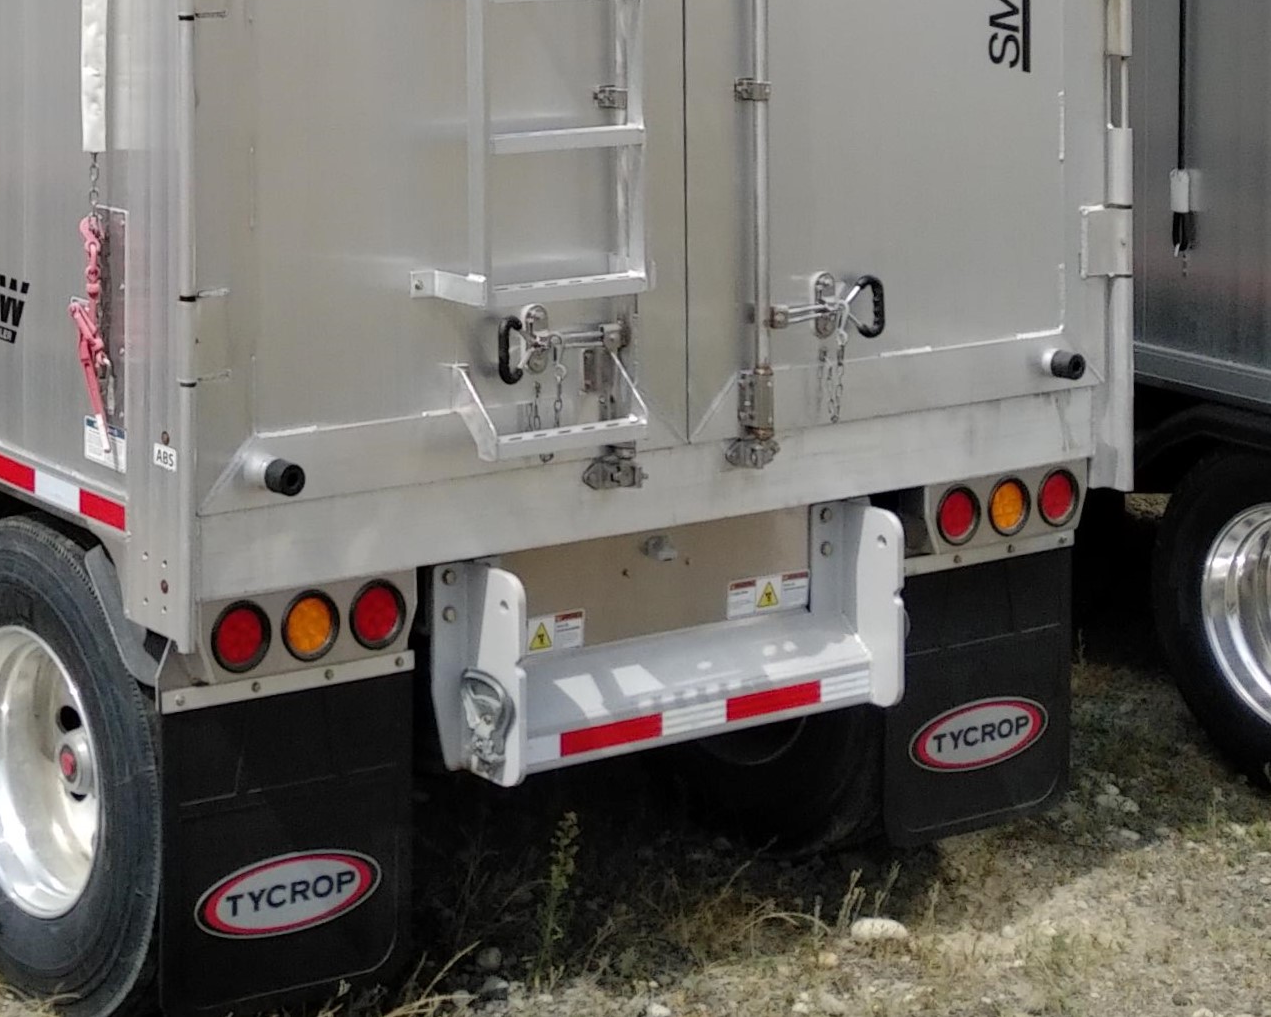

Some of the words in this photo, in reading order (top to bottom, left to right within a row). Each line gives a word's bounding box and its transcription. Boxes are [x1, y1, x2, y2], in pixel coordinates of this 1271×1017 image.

[156, 449, 174, 467] ABS
[932, 715, 1030, 753] TYCROP
[226, 870, 356, 918] TYCROP
